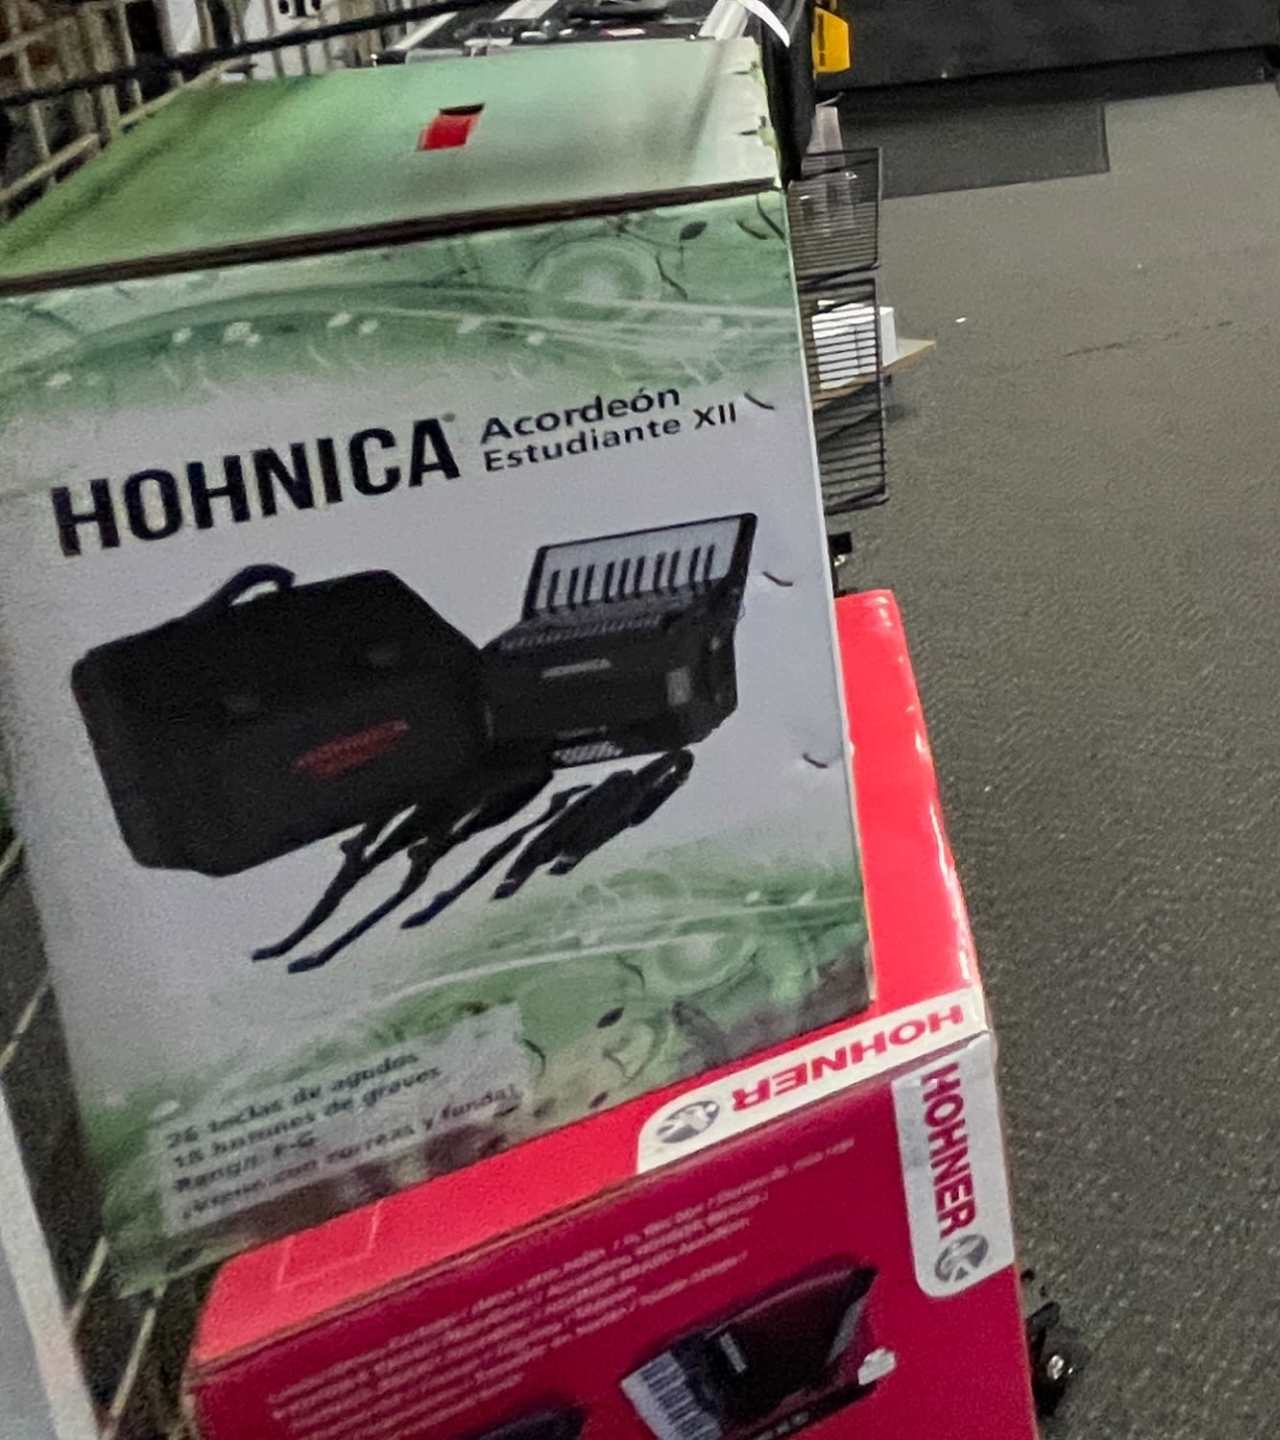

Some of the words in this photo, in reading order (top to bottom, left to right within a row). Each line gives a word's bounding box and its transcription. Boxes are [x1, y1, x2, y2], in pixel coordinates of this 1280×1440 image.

[480, 388, 682, 446] Acordeón
[483, 418, 682, 472] Estudiante
[694, 402, 738, 431] XII
[51, 417, 461, 557] HOHNICA
[731, 1003, 965, 1113] HOHNER
[919, 1061, 978, 1240] HOHNER
